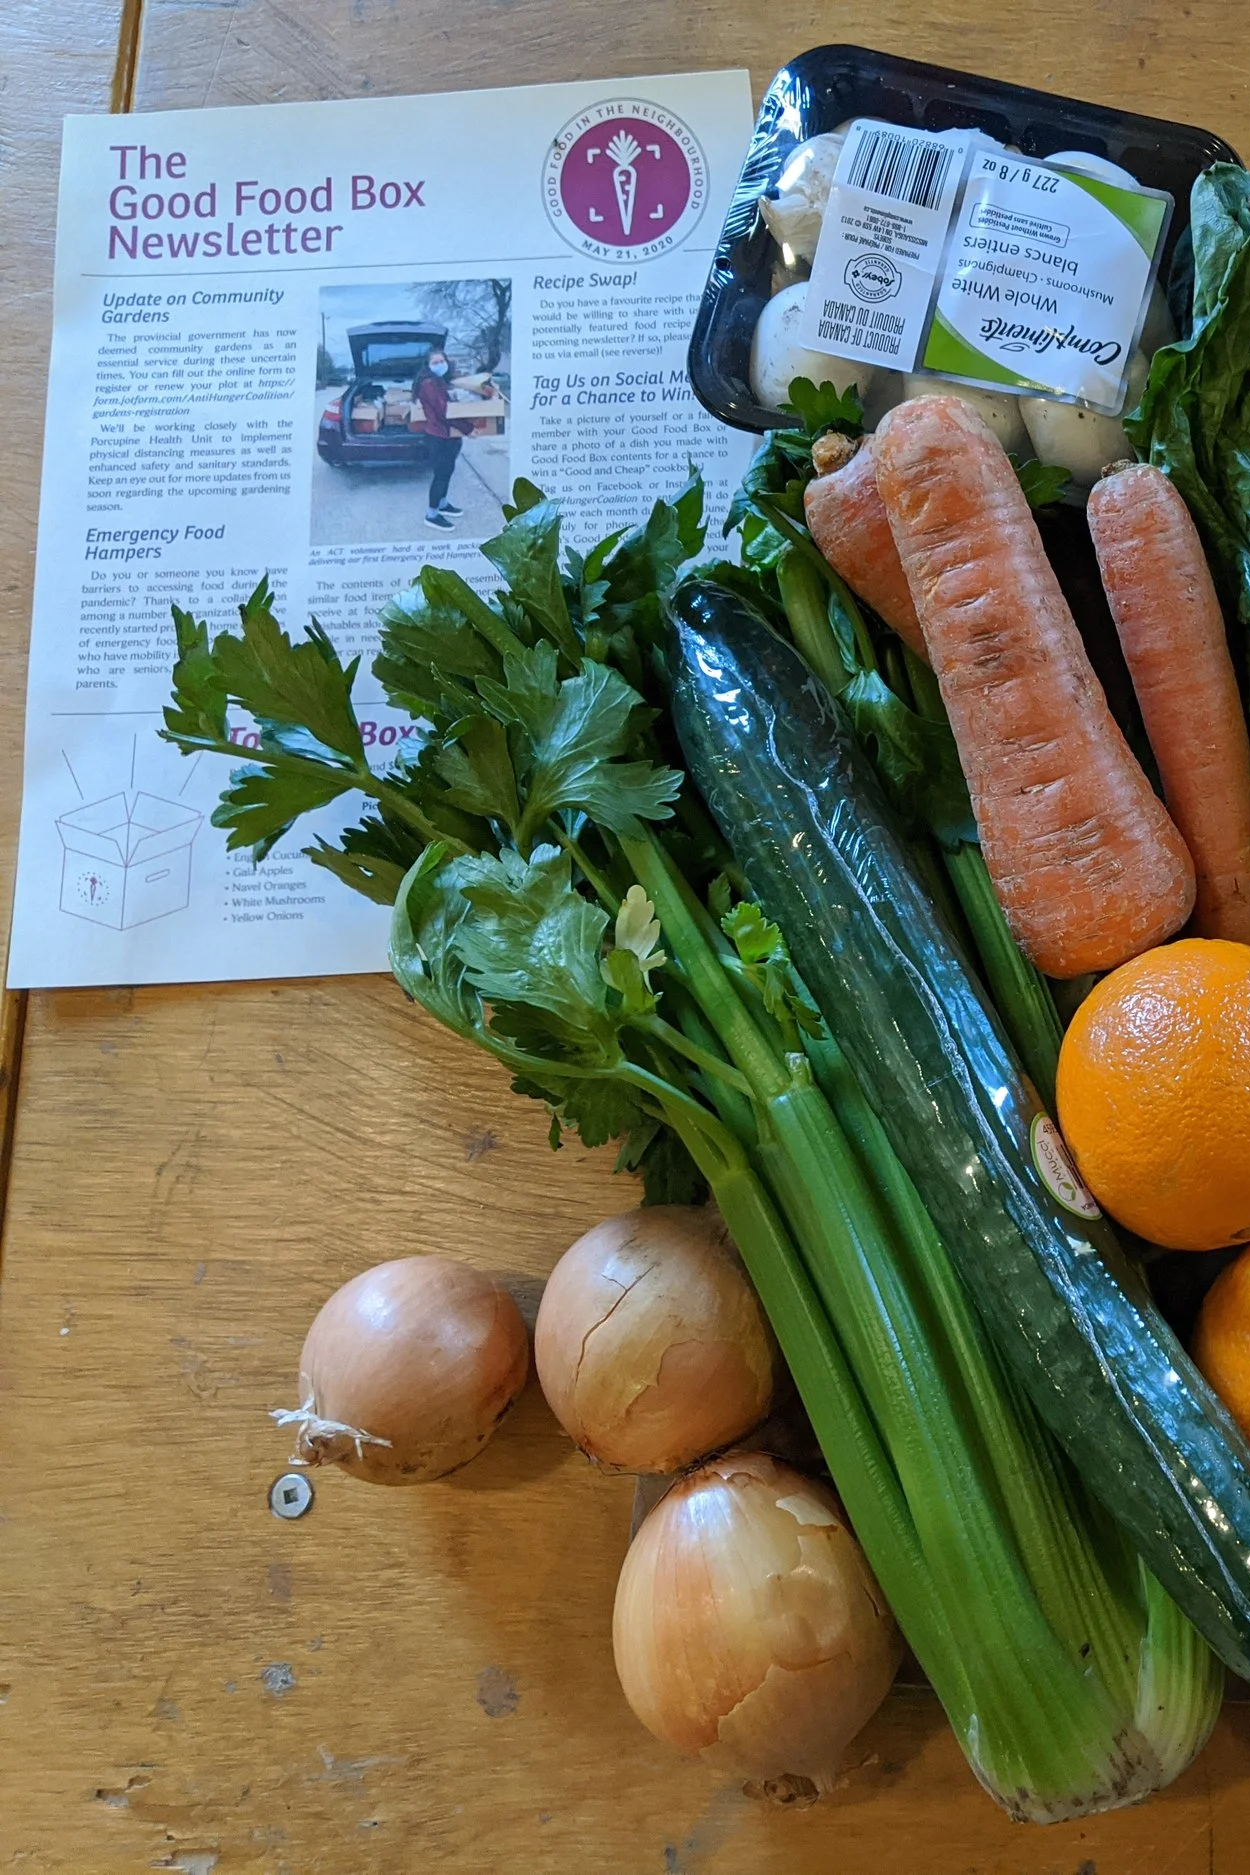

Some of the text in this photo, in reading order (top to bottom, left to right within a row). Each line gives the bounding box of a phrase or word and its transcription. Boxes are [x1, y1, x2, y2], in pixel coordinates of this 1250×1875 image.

[108, 144, 187, 180] The
[548, 104, 704, 217] GOOD FOOD IN THE NEIGHBOURHOOD
[982, 158, 1060, 194] 227 g / 8 oz
[108, 174, 426, 221] Good Food Box
[1011, 225, 1038, 238] Without
[1013, 216, 1053, 233] Cultivé sans
[107, 220, 344, 260] Newsletter
[581, 235, 674, 260] MAY 21, 2020
[1039, 232, 1061, 244] Grown
[963, 235, 1079, 277] blancs entiers
[532, 270, 638, 292] Recipe Swap!
[958, 257, 1114, 306] Mushrooms Champignons
[102, 287, 285, 310] Update on Community
[951, 278, 1059, 314] Whole White
[101, 308, 170, 324] Gardens
[822, 298, 906, 336] PRODUIT DU CANADA
[106, 328, 298, 344] The provincial government has now
[817, 318, 902, 356] PRODUCT OF CANADA
[980, 316, 1122, 366] Compliments
[531, 344, 663, 360] to us via email (see reverse)!
[533, 374, 561, 392] Tag
[565, 373, 585, 388] Us
[590, 375, 610, 387] on
[614, 370, 664, 386] Social
[529, 391, 557, 410] for
[561, 394, 571, 405] a
[576, 390, 636, 405] Chance
[640, 389, 656, 403] to
[85, 523, 226, 545] Emergency Food
[84, 545, 162, 563] Hampers
[359, 720, 415, 747] Box
[259, 865, 294, 878] Apples
[232, 881, 307, 892] Navel Oranges
[232, 895, 326, 907] White Mushrooms
[231, 911, 304, 923] Yellow Onions
